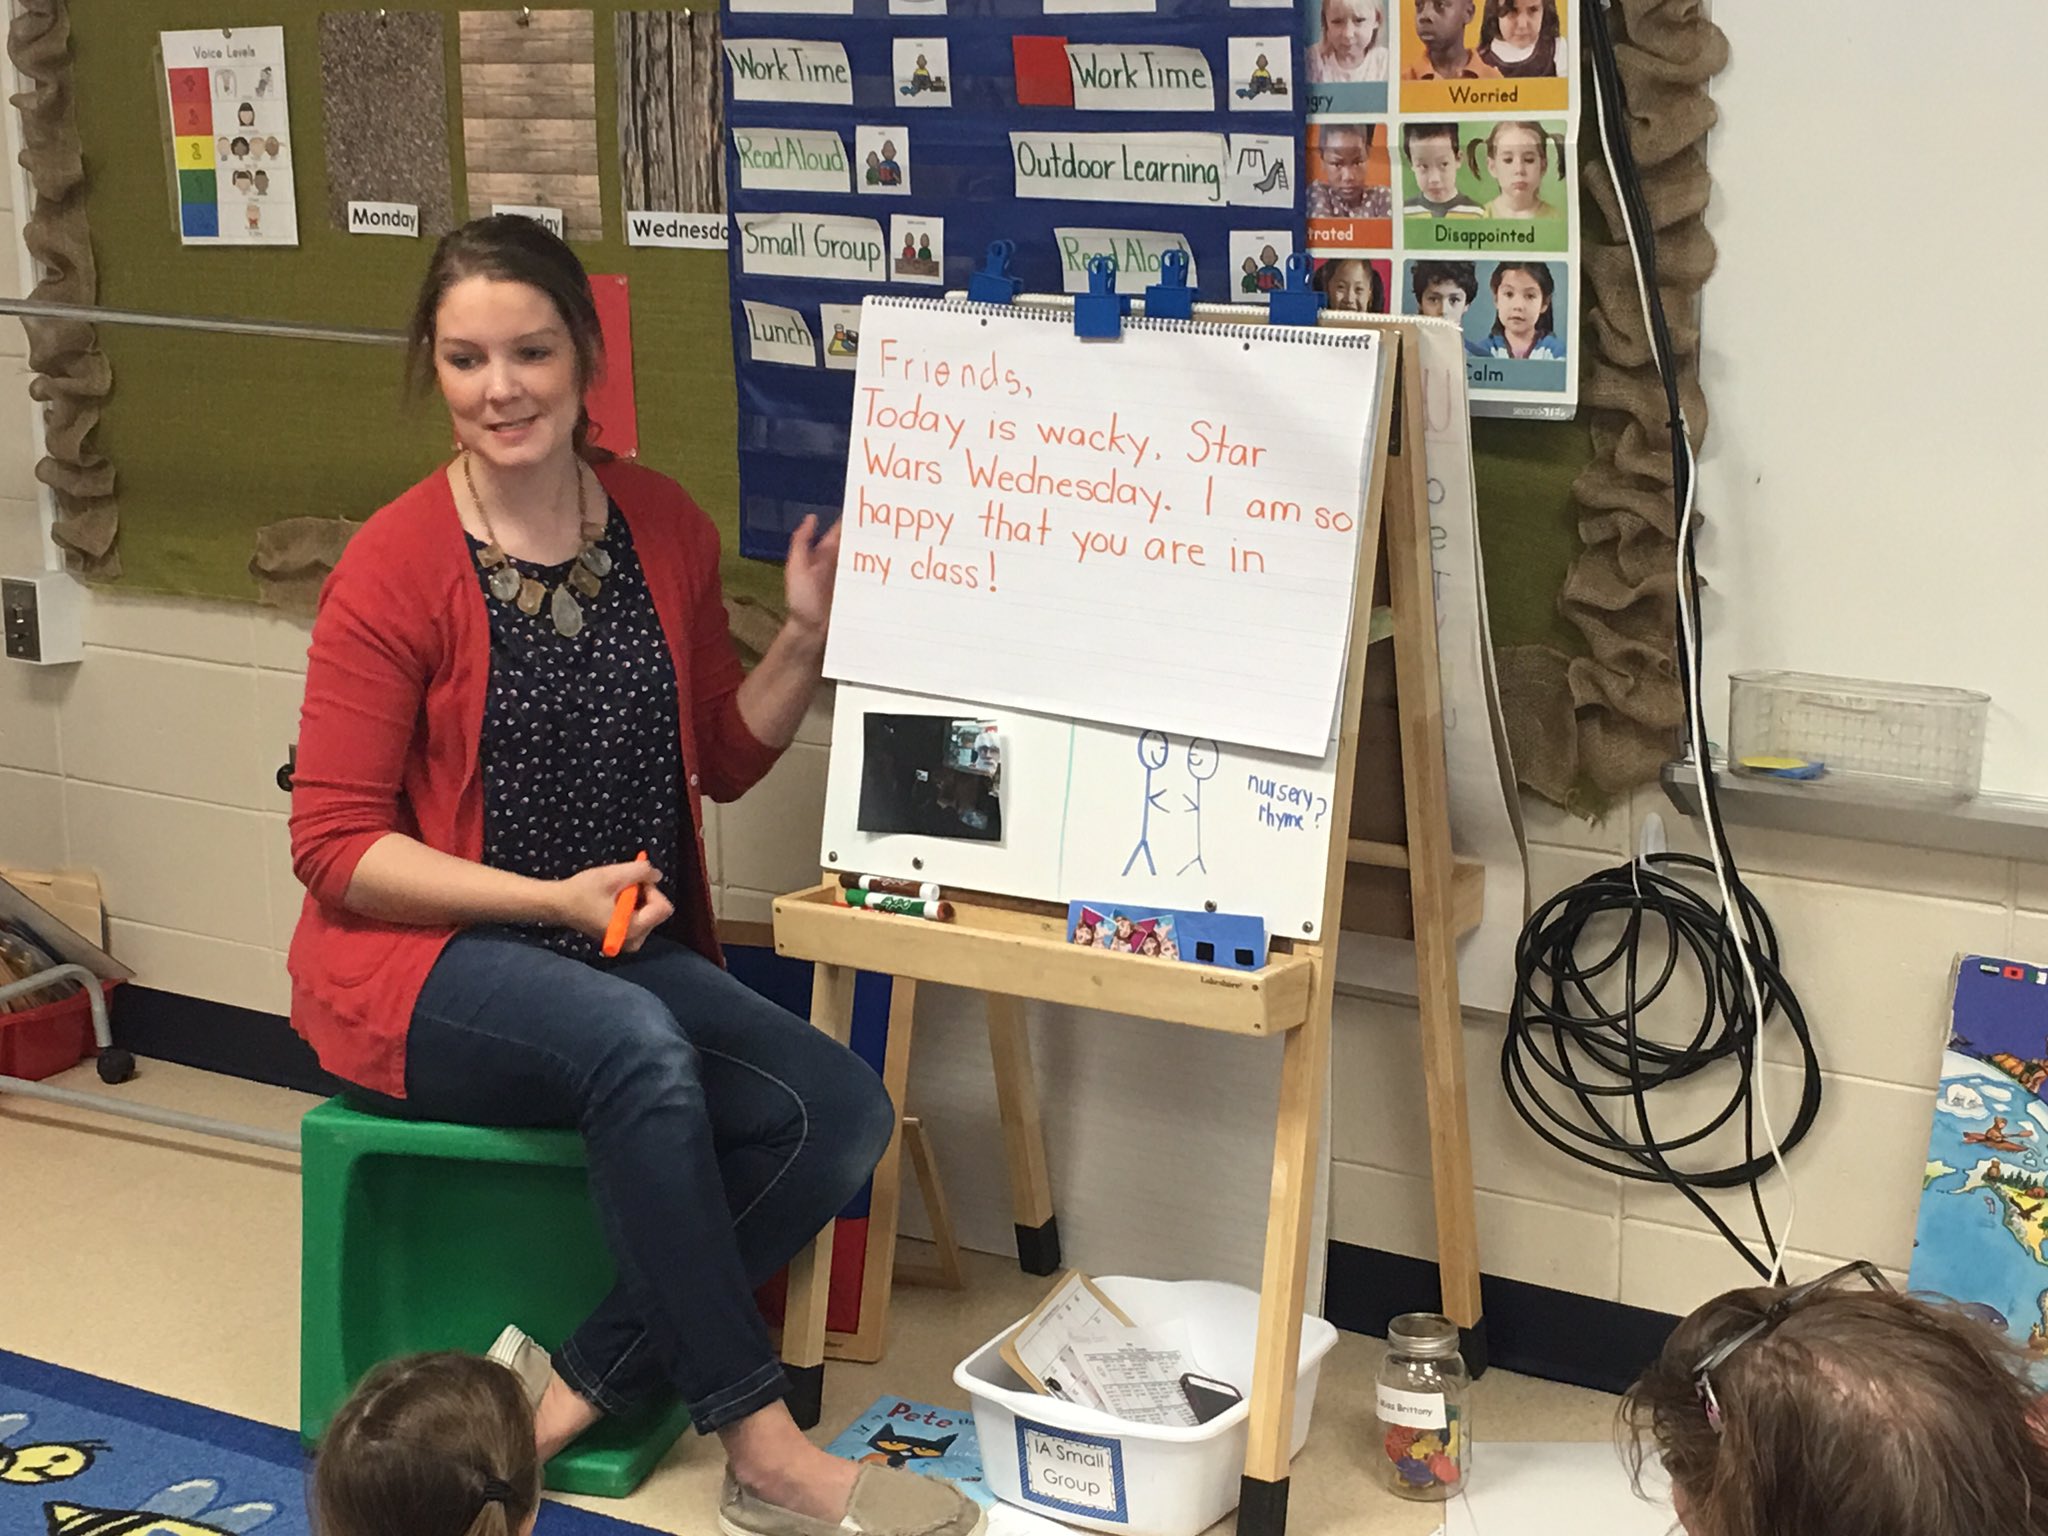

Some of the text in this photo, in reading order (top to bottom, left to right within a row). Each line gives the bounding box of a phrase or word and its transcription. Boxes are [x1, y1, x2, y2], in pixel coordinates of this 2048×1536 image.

[192, 44, 256, 59] Voice Levels
[728, 47, 848, 83] Work Time
[1070, 51, 1207, 89] Work Time
[1448, 85, 1519, 105] Worried
[737, 136, 844, 172] Read Aloud
[1017, 141, 1221, 201] Outdoor Learning
[353, 208, 416, 232] Monday
[1435, 224, 1535, 249] Disappointed
[744, 221, 881, 272] Small Group
[749, 309, 811, 346] Lunch
[881, 339, 1032, 398] Friends,
[862, 387, 965, 450] Today
[989, 410, 1016, 441] is
[1187, 420, 1267, 467] Star
[864, 437, 1354, 532] Wars Wednesday. I am so
[858, 485, 1264, 573] happy that you are in
[854, 546, 997, 593] my class!
[1247, 774, 1313, 812] nursery
[887, 1402, 953, 1429] Pete
[1035, 1438, 1104, 1468] IA Small
[1043, 1468, 1100, 1496] Group
